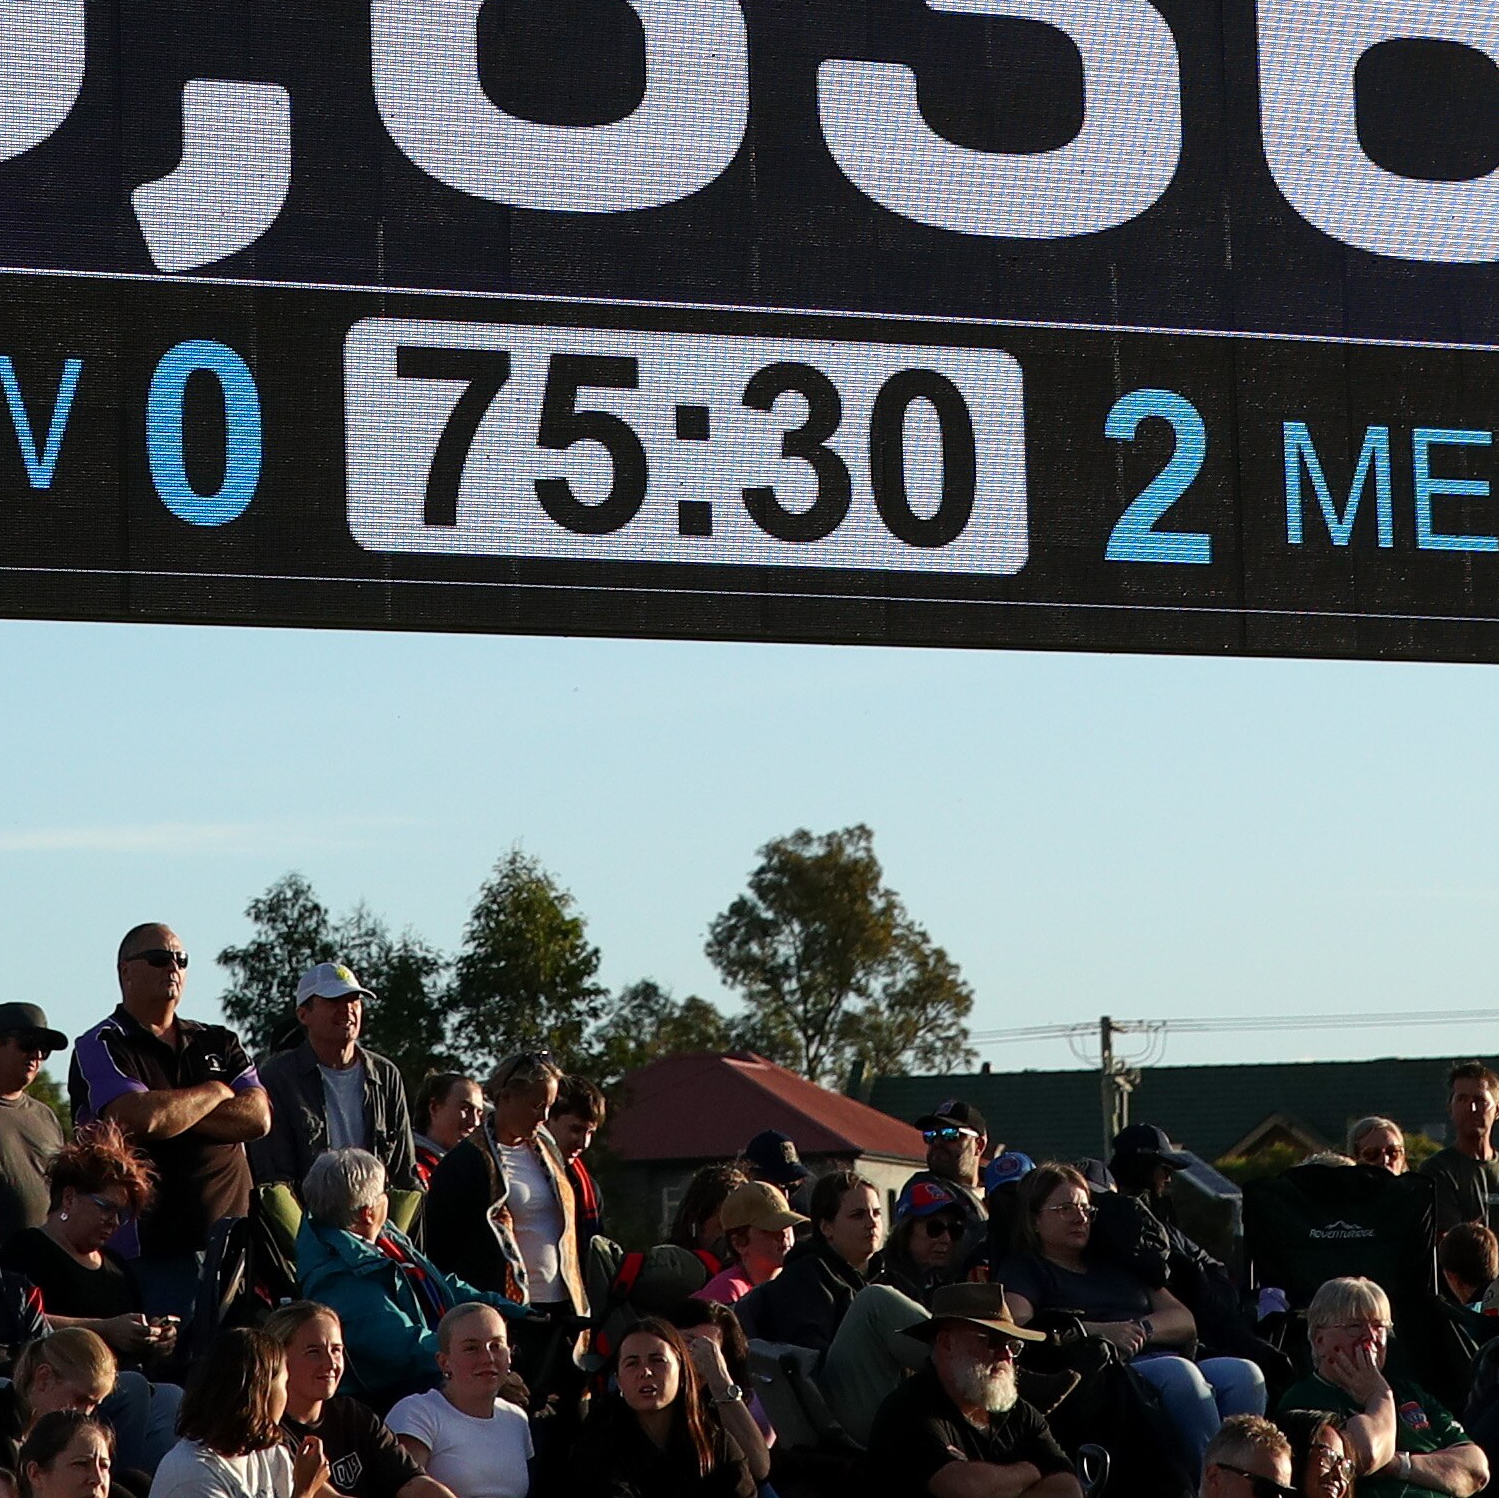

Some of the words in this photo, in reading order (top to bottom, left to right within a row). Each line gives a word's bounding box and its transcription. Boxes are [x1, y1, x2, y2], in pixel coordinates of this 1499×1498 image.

[144, 338, 263, 527] 0
[395, 345, 977, 549] 75:30
[1103, 387, 1213, 565] 2
